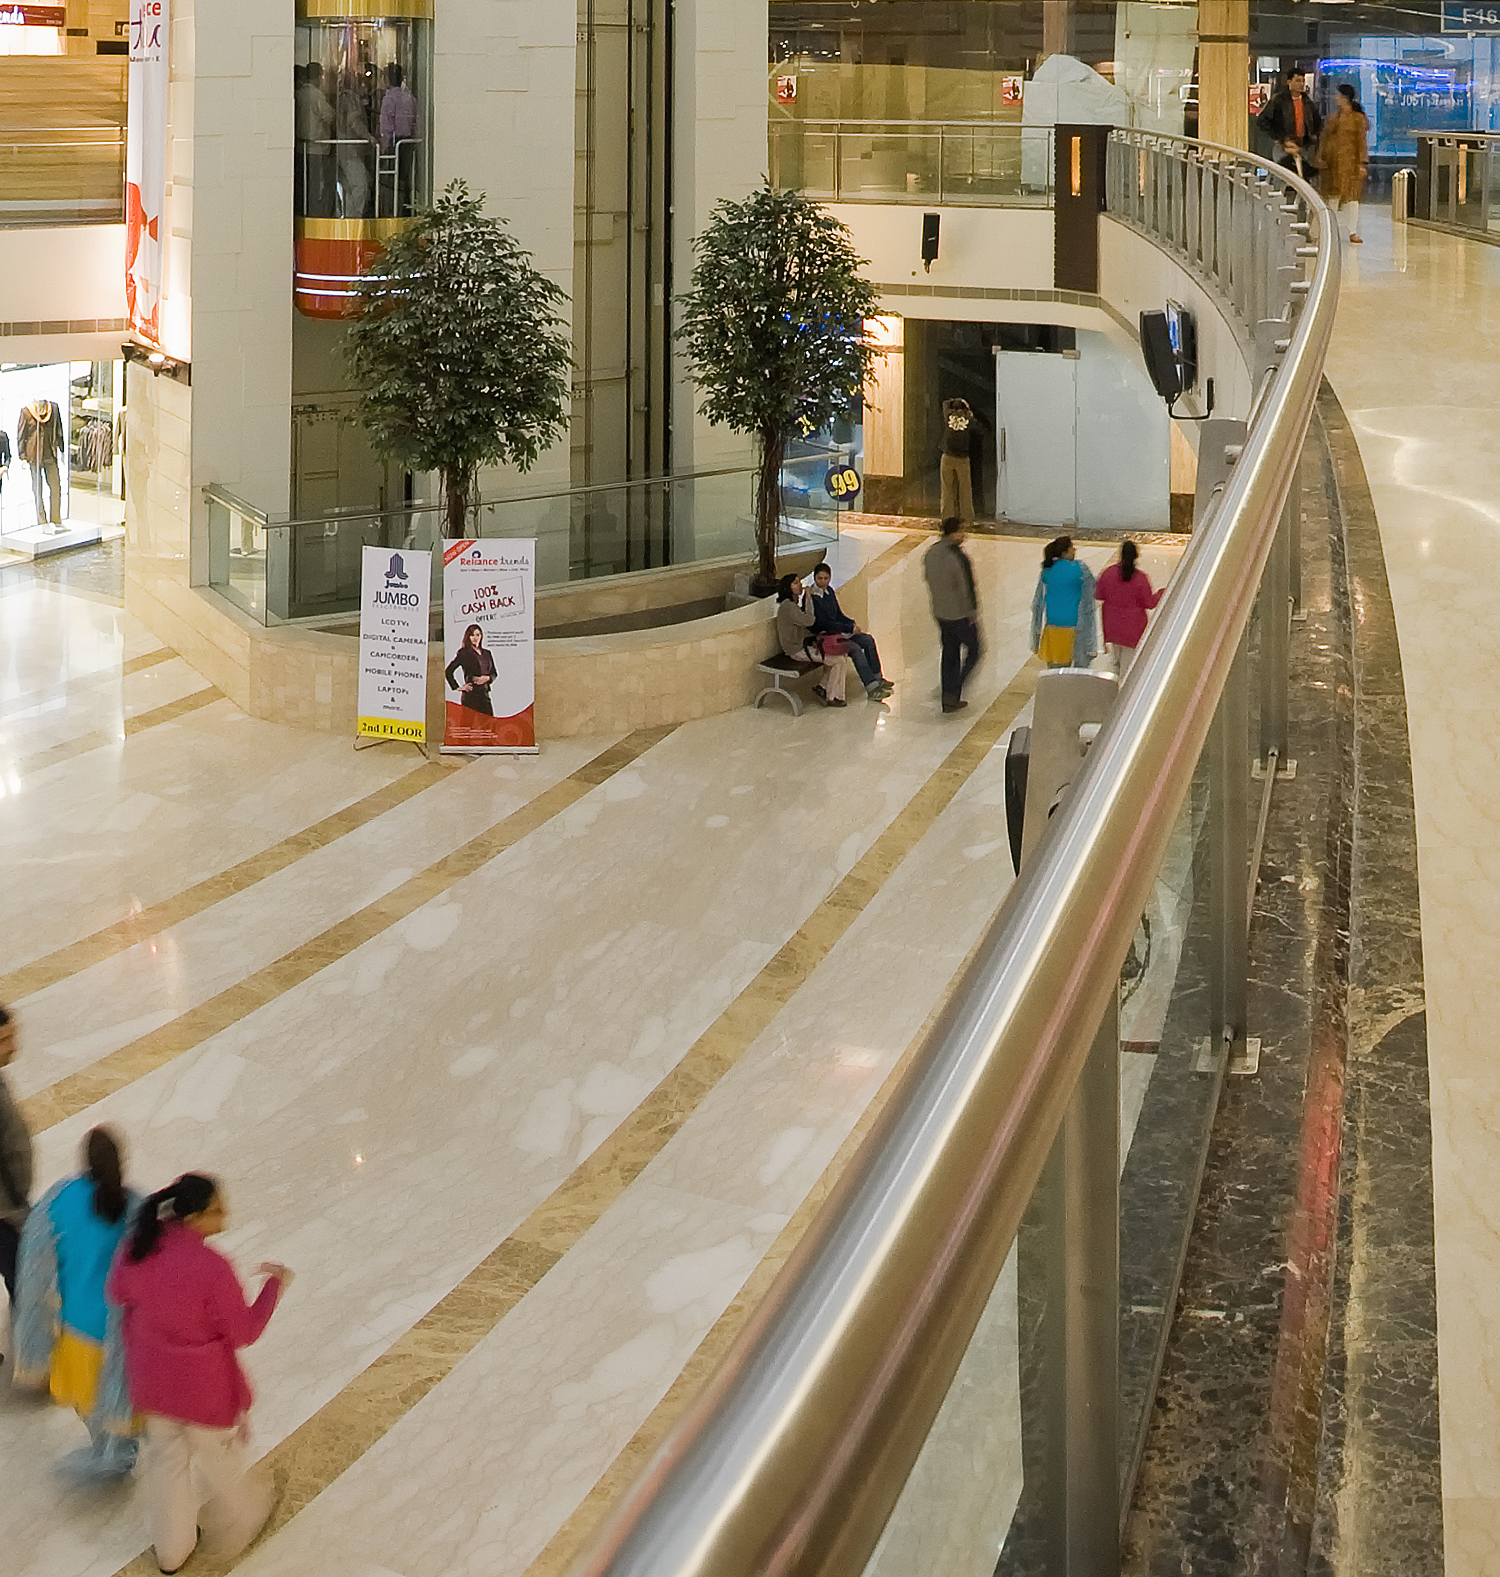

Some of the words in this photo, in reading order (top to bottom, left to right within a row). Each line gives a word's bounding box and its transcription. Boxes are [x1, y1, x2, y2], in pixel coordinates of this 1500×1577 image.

[460, 557, 498, 566] Reliance
[500, 556, 529, 566] trends
[473, 585, 499, 600] 100%
[373, 591, 419, 607] JUMBO
[372, 604, 419, 612] ELECTRONICS
[461, 601, 487, 615] CASH
[489, 596, 516, 610] BACK
[363, 634, 391, 642] DIGITAL
[365, 668, 392, 676] MOBILE
[362, 723, 380, 733] 2nd
[383, 725, 423, 737] FLOOR
